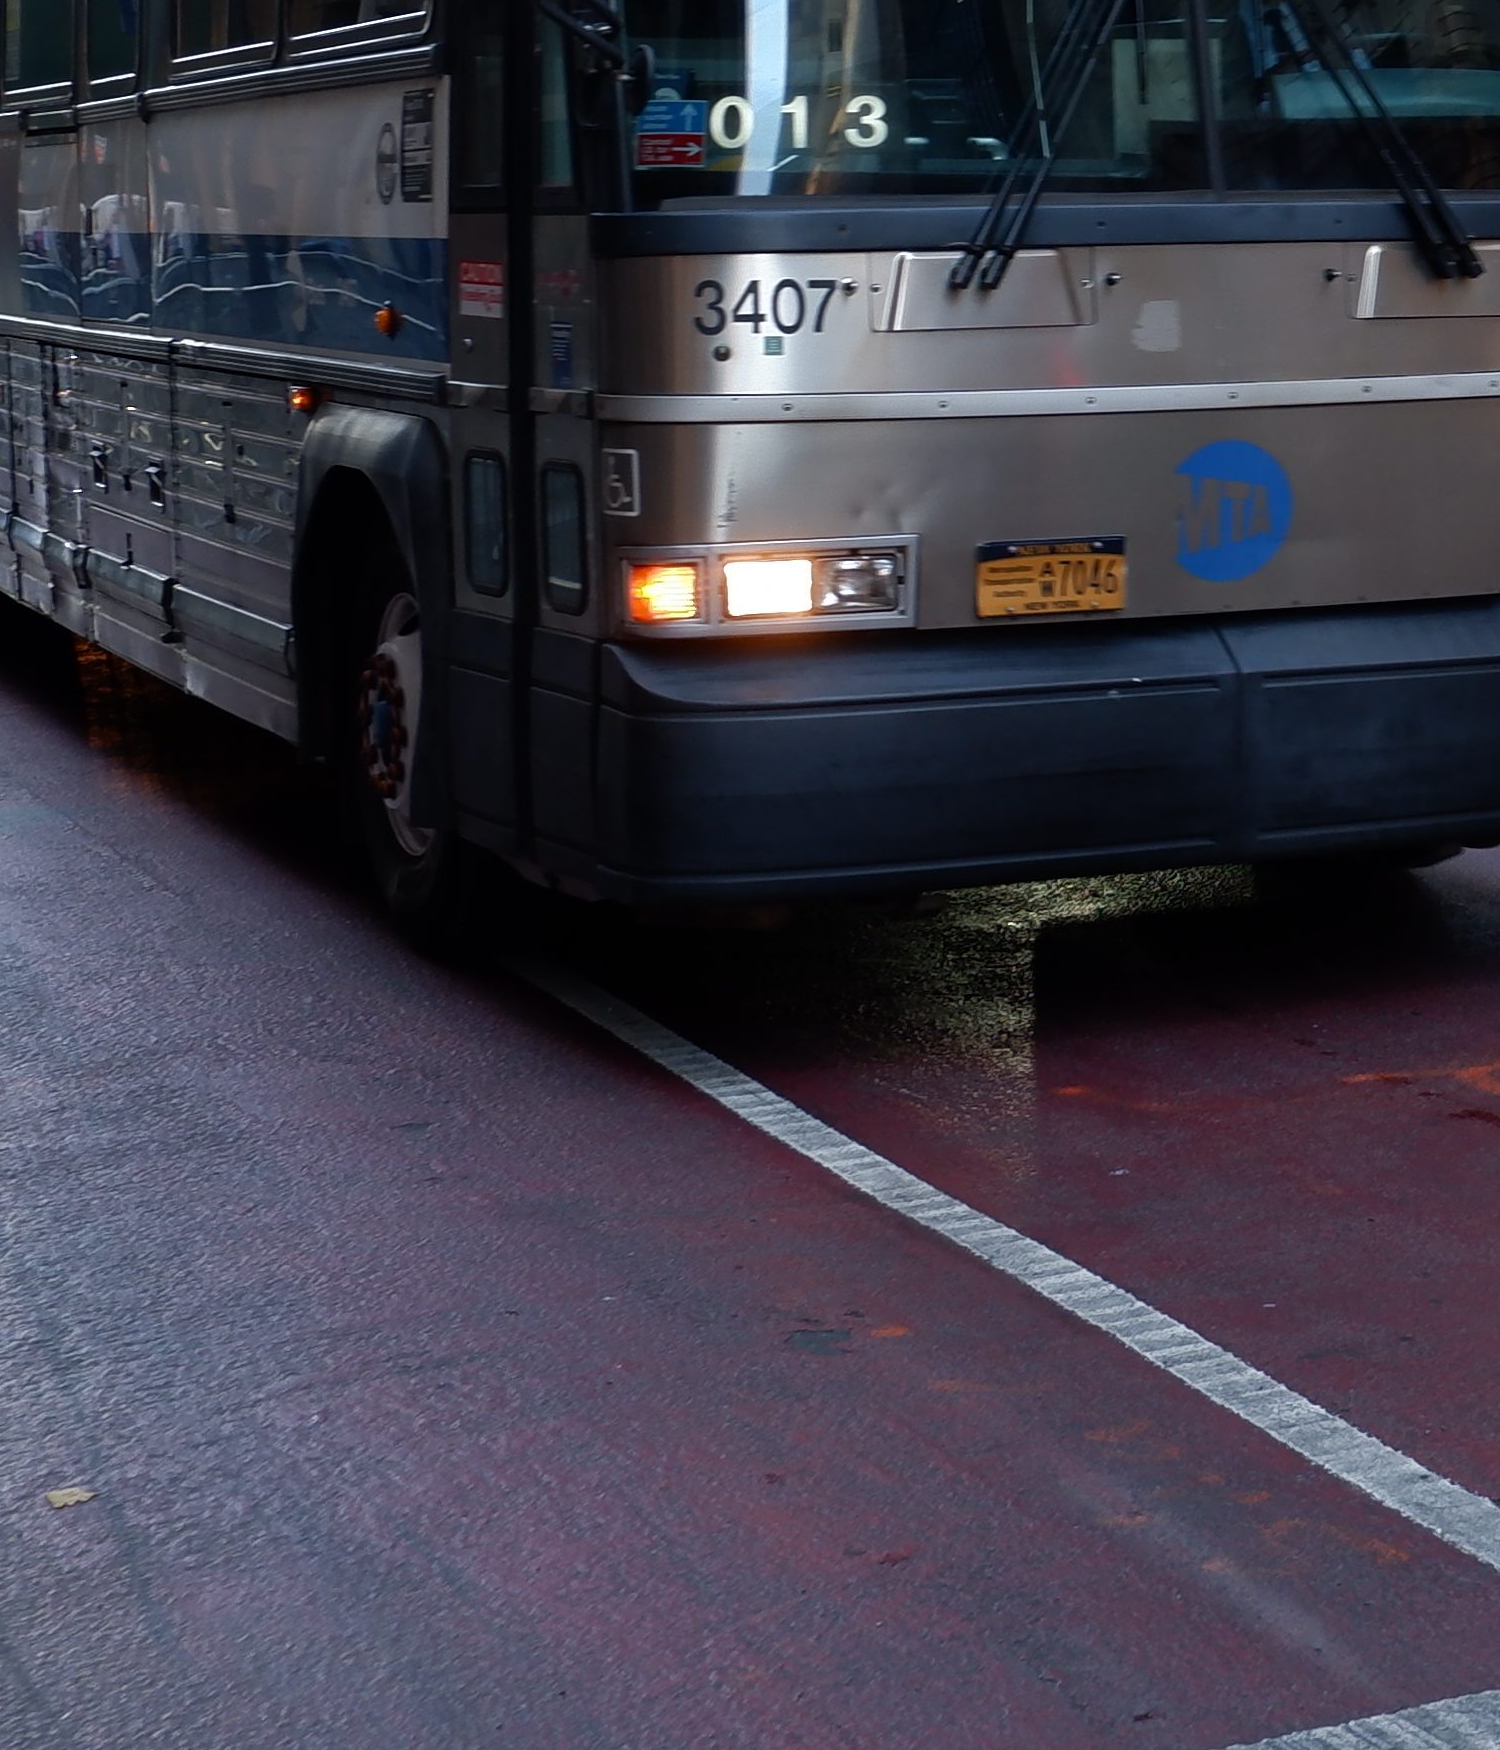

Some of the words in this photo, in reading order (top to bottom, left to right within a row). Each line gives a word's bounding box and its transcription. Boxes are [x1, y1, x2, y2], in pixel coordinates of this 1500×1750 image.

[708, 94, 889, 150] 013
[693, 278, 838, 336] 3407
[1057, 558, 1120, 597] 7046
